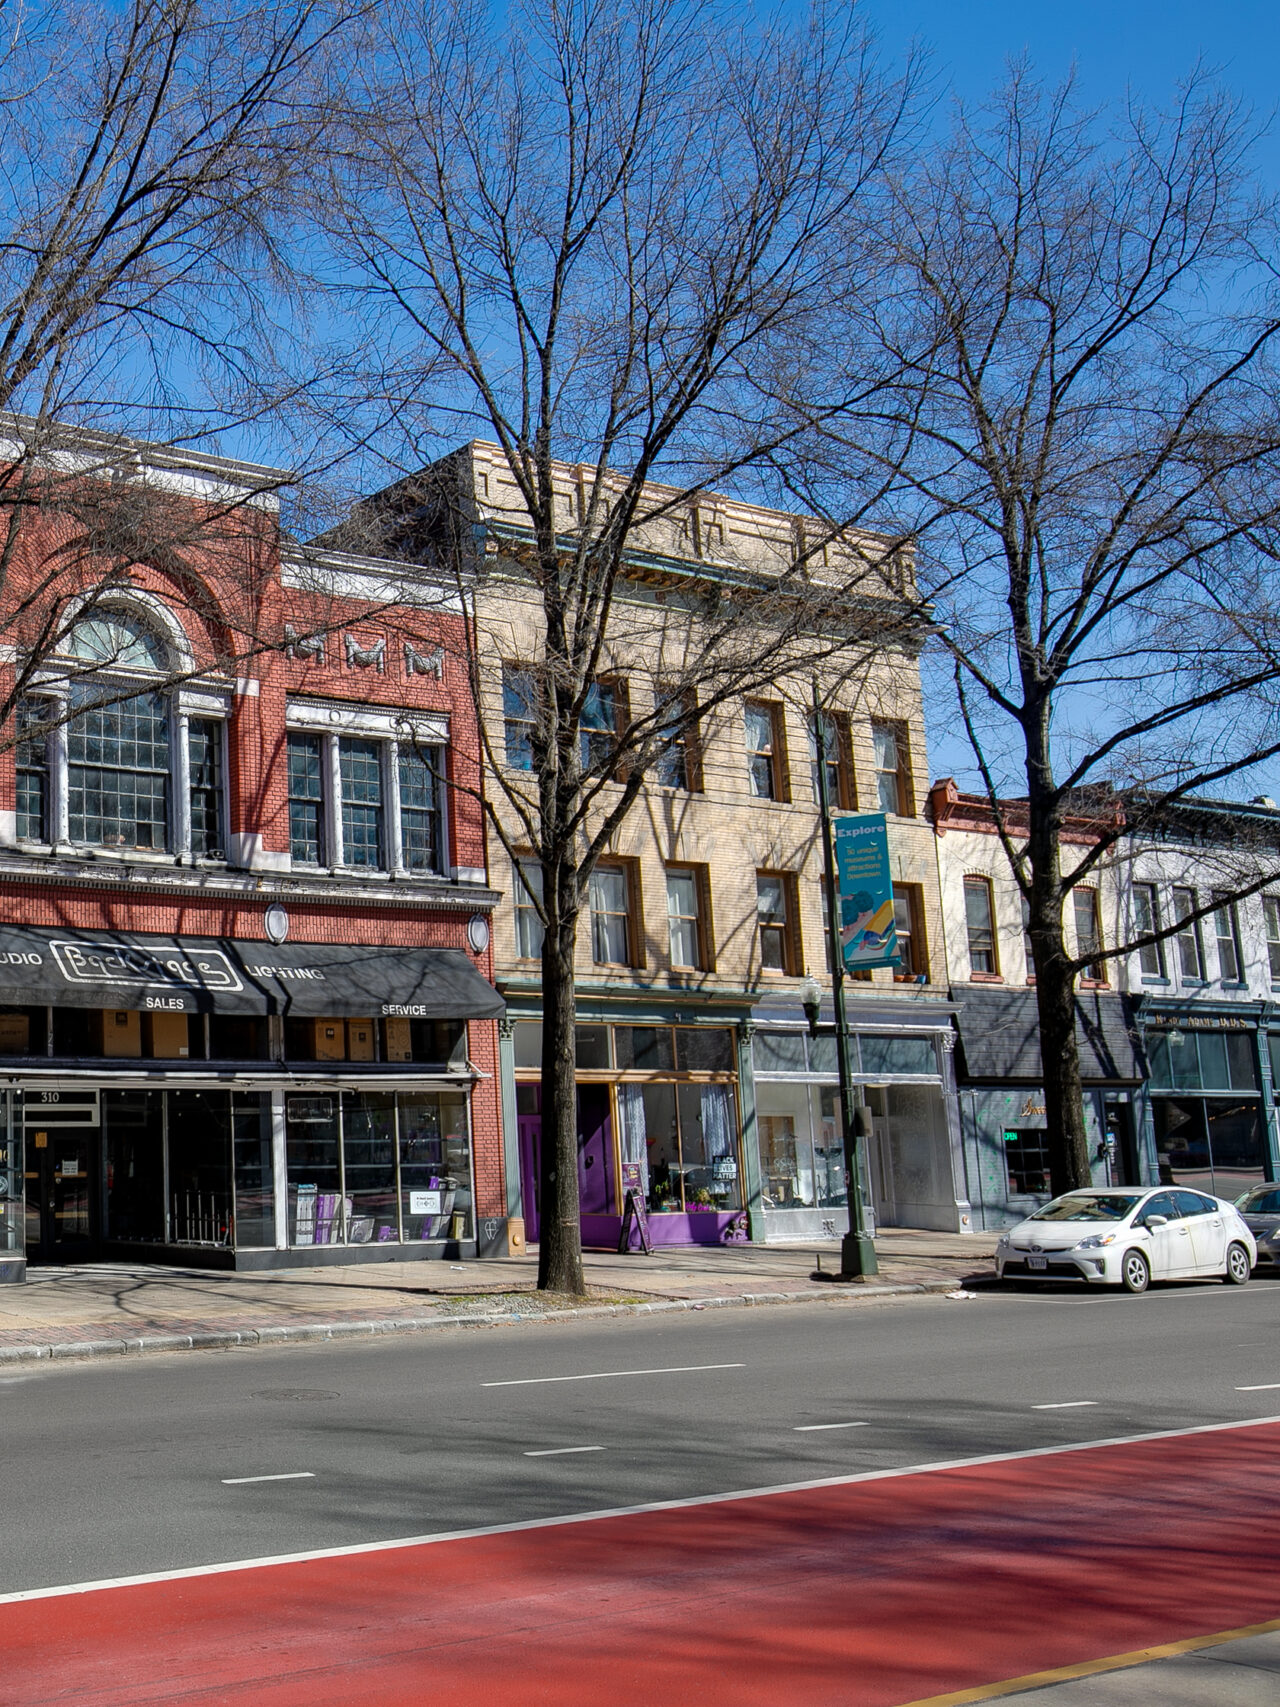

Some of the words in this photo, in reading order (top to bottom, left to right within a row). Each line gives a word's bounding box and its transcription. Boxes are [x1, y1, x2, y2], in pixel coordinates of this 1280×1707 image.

[837, 825, 885, 837] Explore
[244, 965, 326, 980] LIGHTING
[146, 997, 184, 1010] SALES
[382, 1004, 427, 1016] SERVICE
[41, 1092, 60, 1103] 310
[1003, 1131, 1018, 1141] OPEN
[714, 1156, 735, 1164] BLACK
